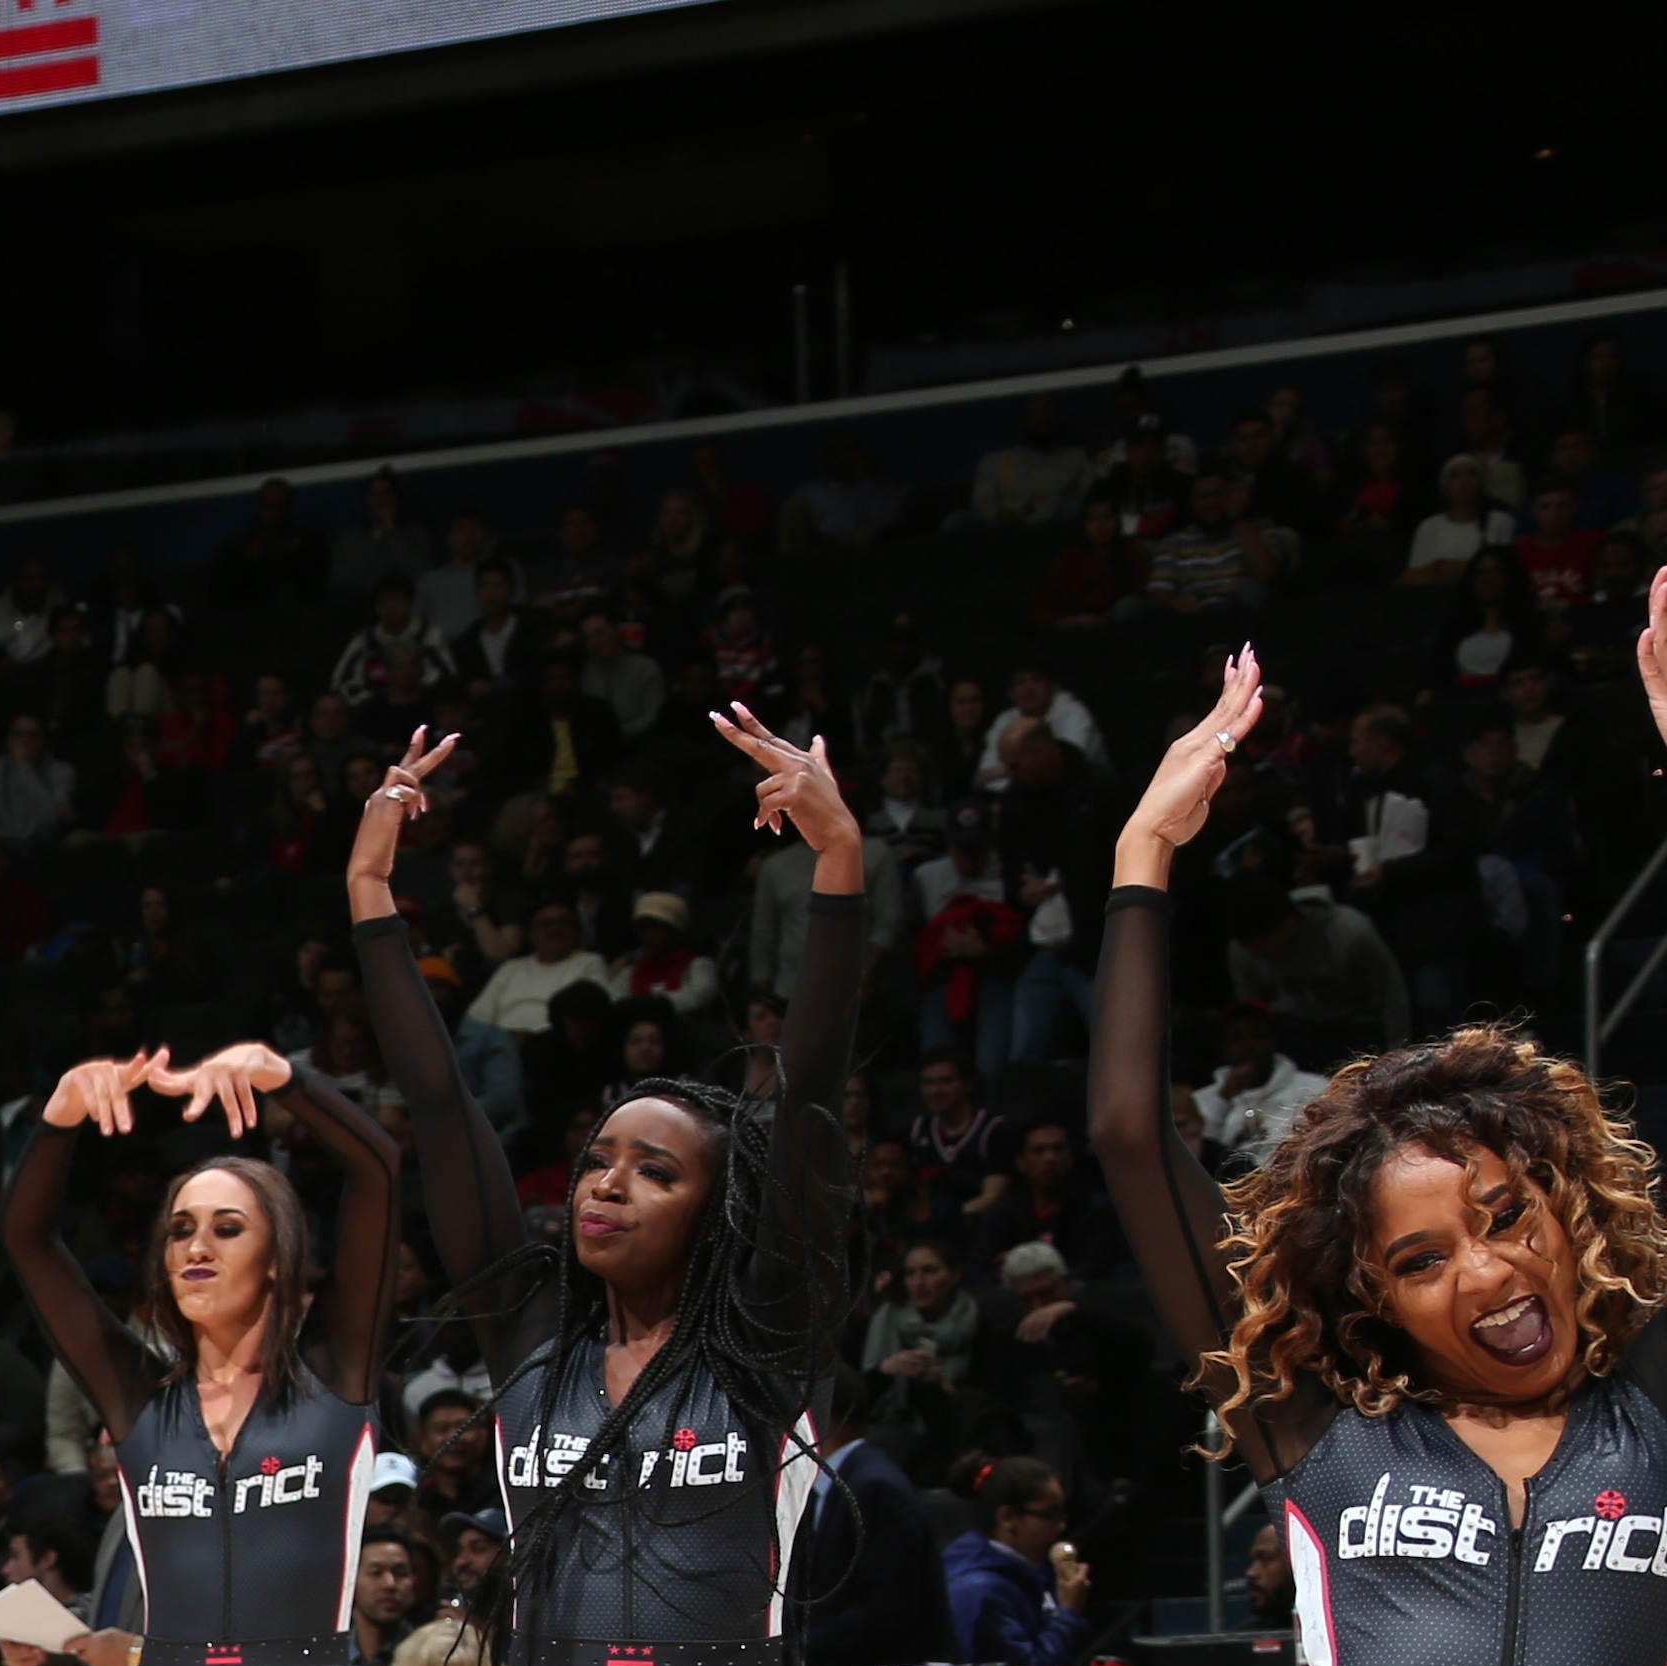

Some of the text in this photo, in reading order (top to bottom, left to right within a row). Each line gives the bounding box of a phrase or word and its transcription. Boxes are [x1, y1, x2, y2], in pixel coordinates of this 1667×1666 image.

[553, 1433, 591, 1451] THE
[165, 1471, 197, 1485] THE
[1408, 1485, 1466, 1510] THE
